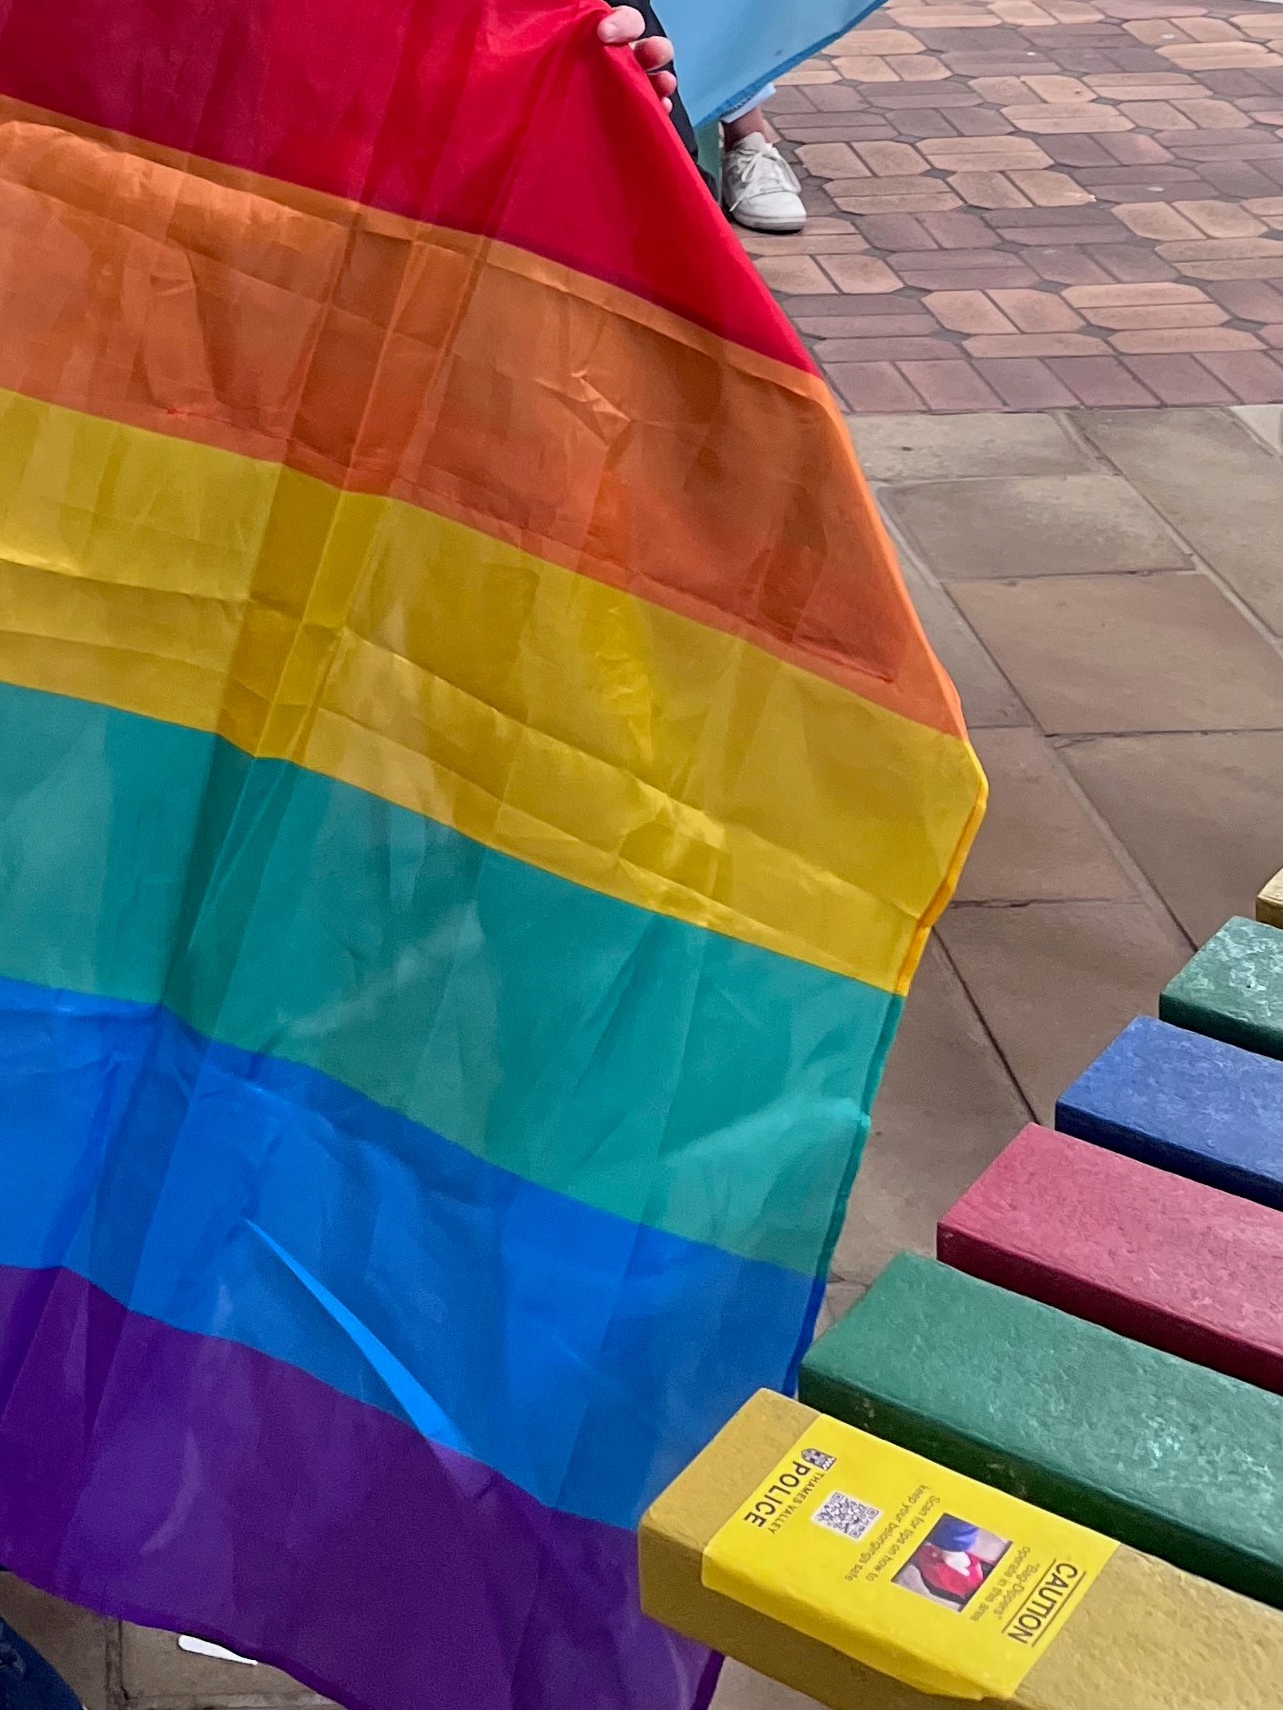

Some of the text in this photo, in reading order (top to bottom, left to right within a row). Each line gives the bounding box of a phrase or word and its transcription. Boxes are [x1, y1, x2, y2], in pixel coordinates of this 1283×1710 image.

[743, 1461, 811, 1527] POLICE
[768, 1472, 825, 1534] THAMES VALLEY
[895, 1503, 910, 1523] your
[859, 1522, 898, 1563] belongings
[865, 1495, 941, 1582] Scan for tips on how to
[1004, 1546, 1031, 1578] operate
[997, 1578, 1008, 1587] in
[1008, 1563, 1078, 1644] CAUTION
